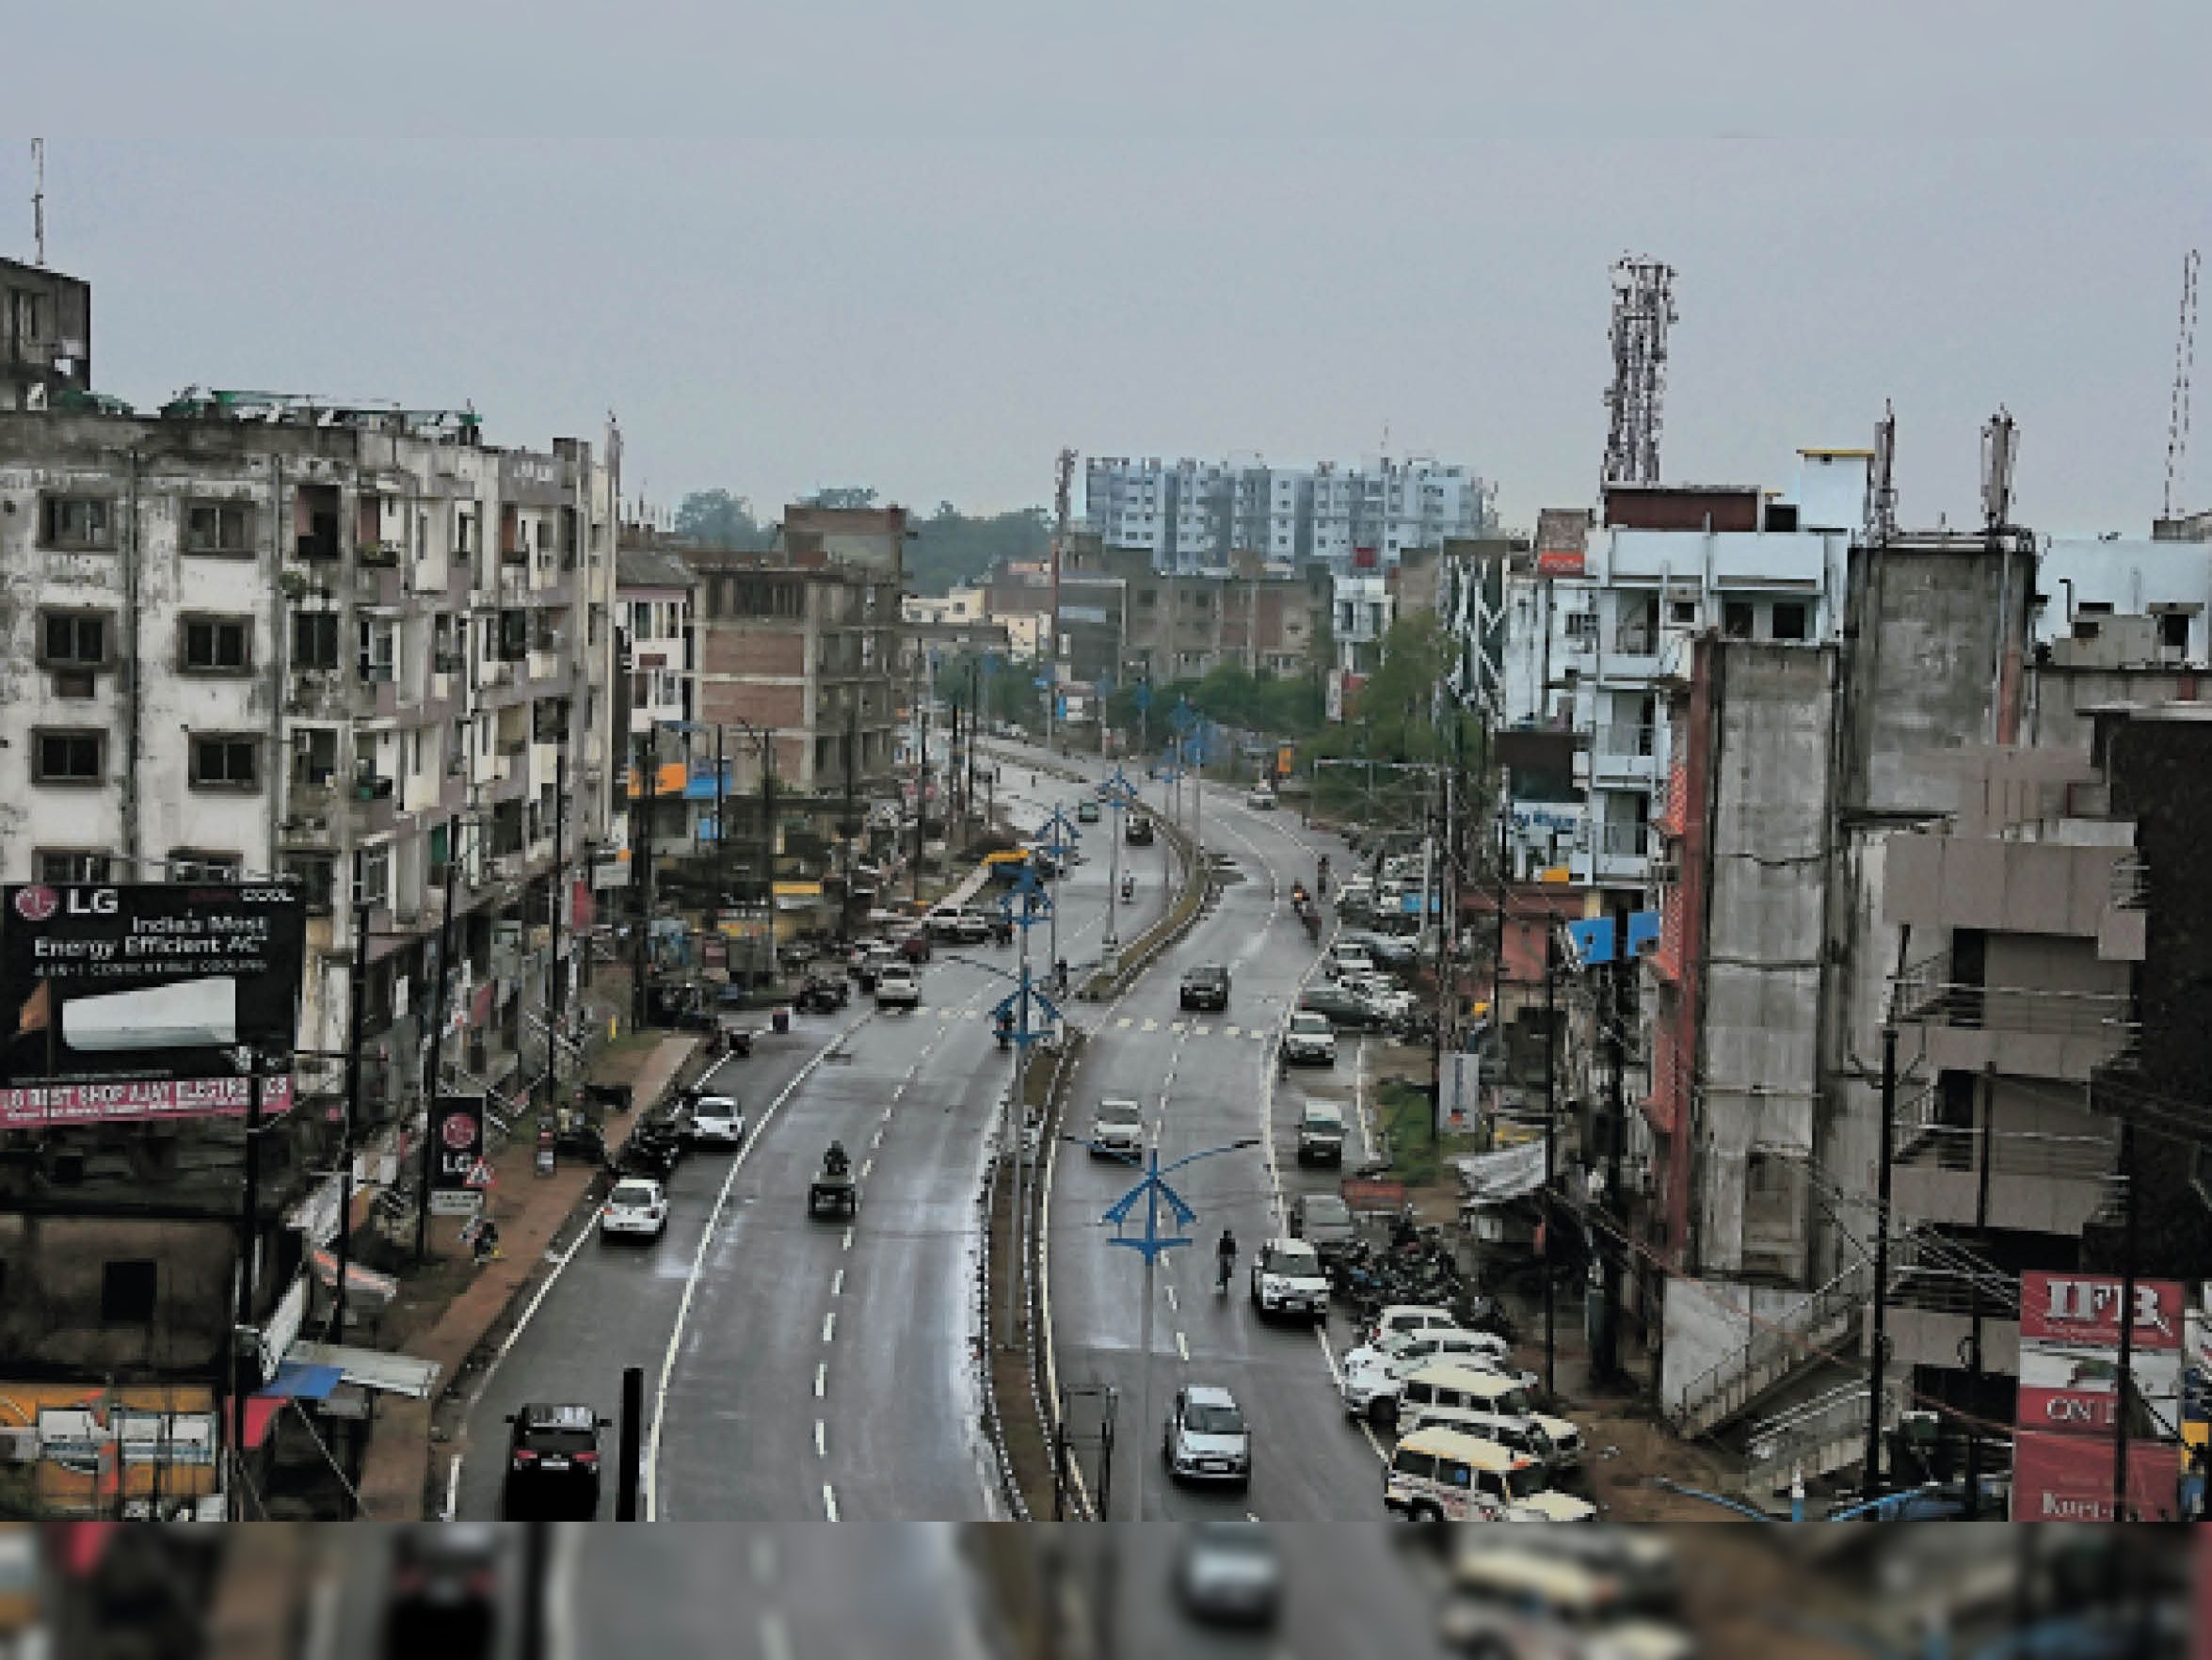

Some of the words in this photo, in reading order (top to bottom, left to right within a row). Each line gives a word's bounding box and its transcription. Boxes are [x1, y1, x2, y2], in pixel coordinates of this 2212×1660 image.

[67, 888, 119, 914] LG
[34, 936, 117, 961] Energy
[124, 935, 220, 954] Efficient
